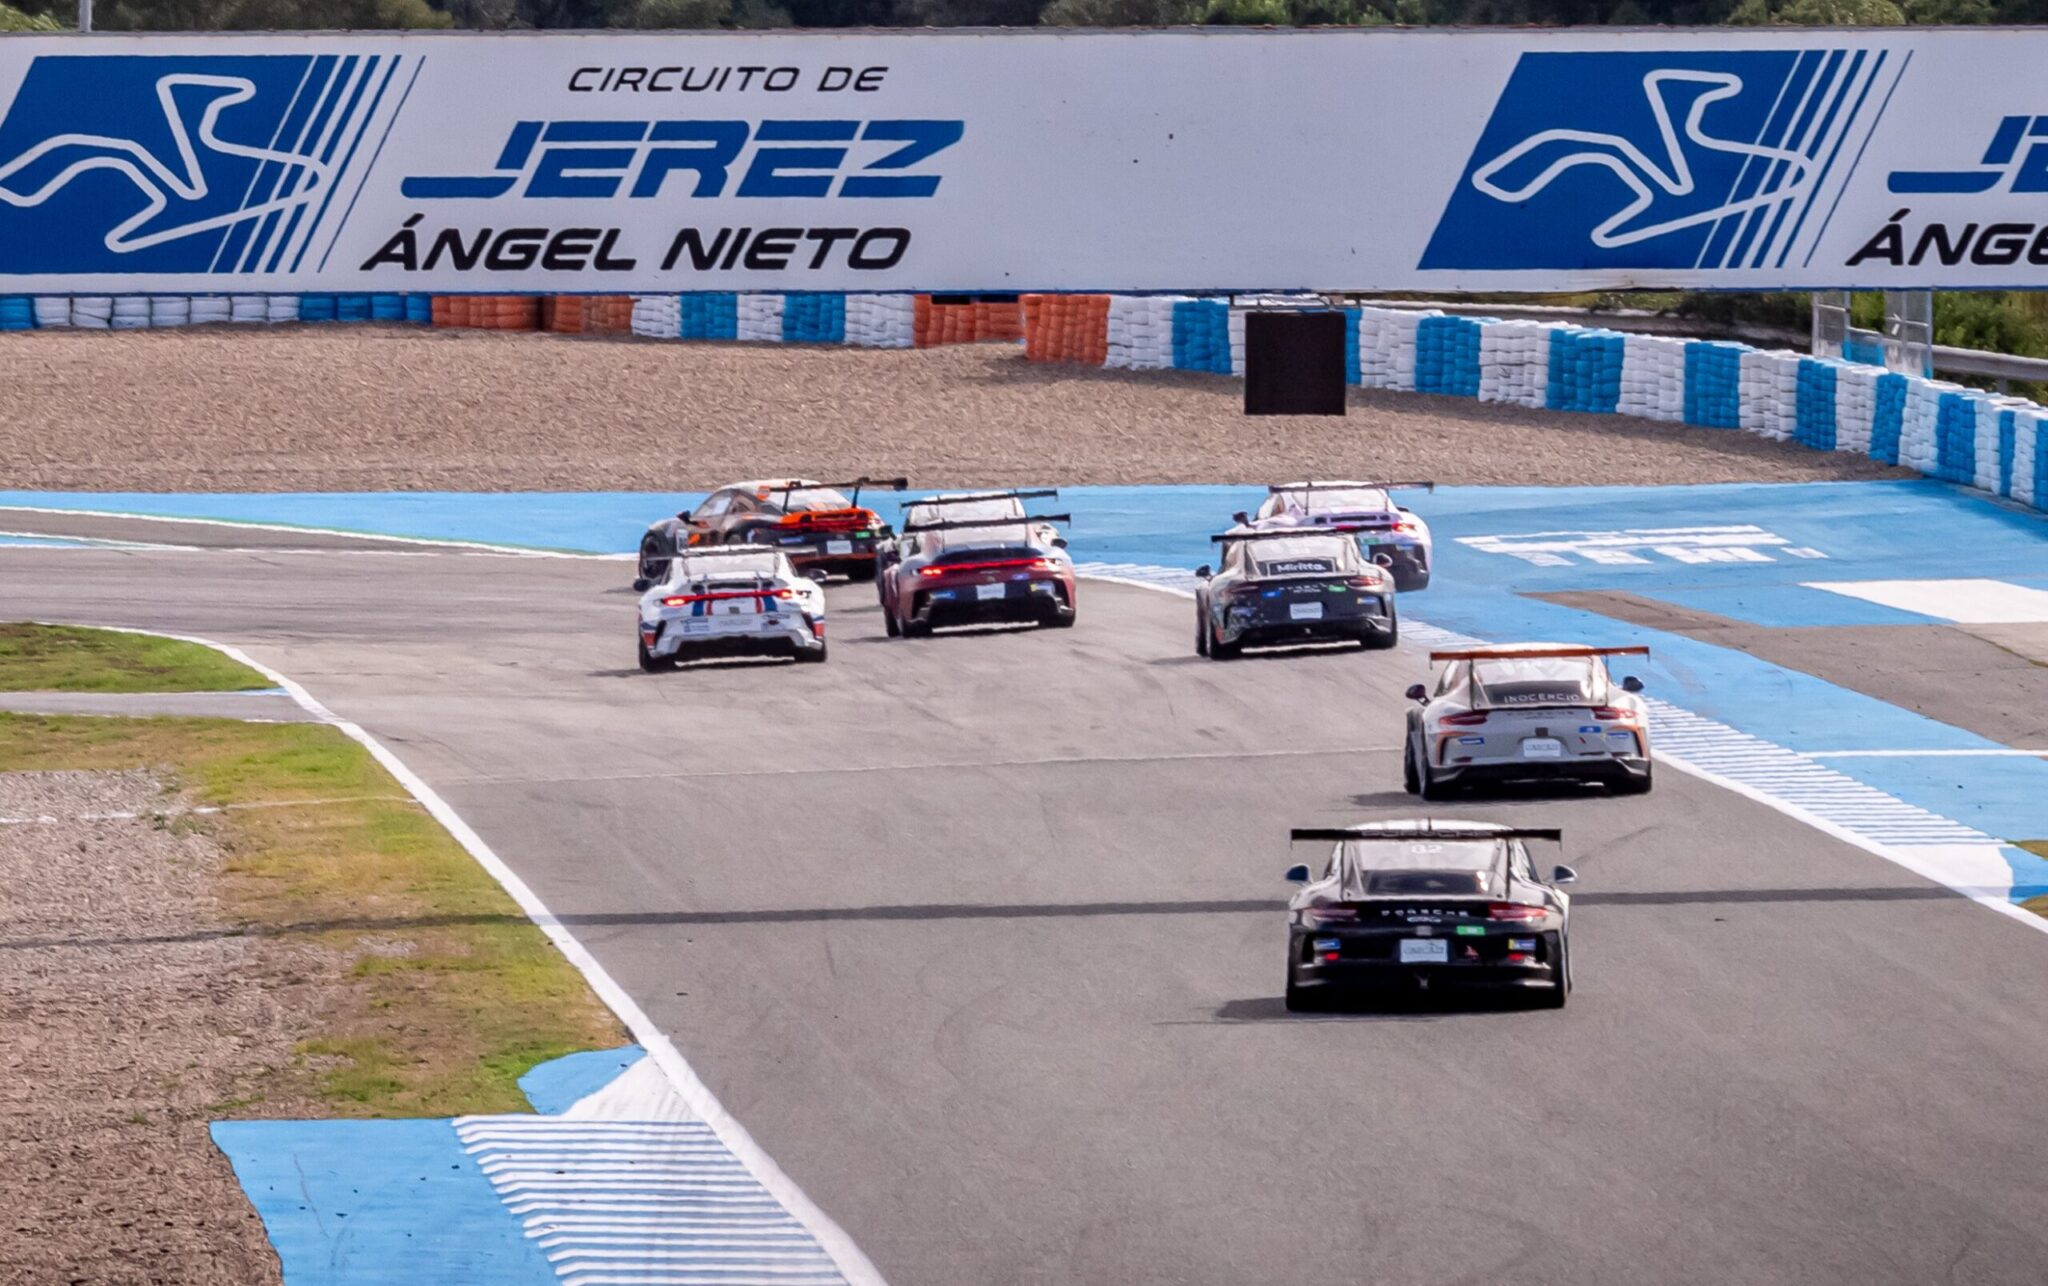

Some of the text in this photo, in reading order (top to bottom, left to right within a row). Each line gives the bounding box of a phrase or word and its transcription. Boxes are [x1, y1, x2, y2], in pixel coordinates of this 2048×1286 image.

[568, 66, 889, 93] CIRCUITO DE
[401, 119, 965, 199] JEREZ
[360, 212, 912, 272] ÁNGEL NIETO
